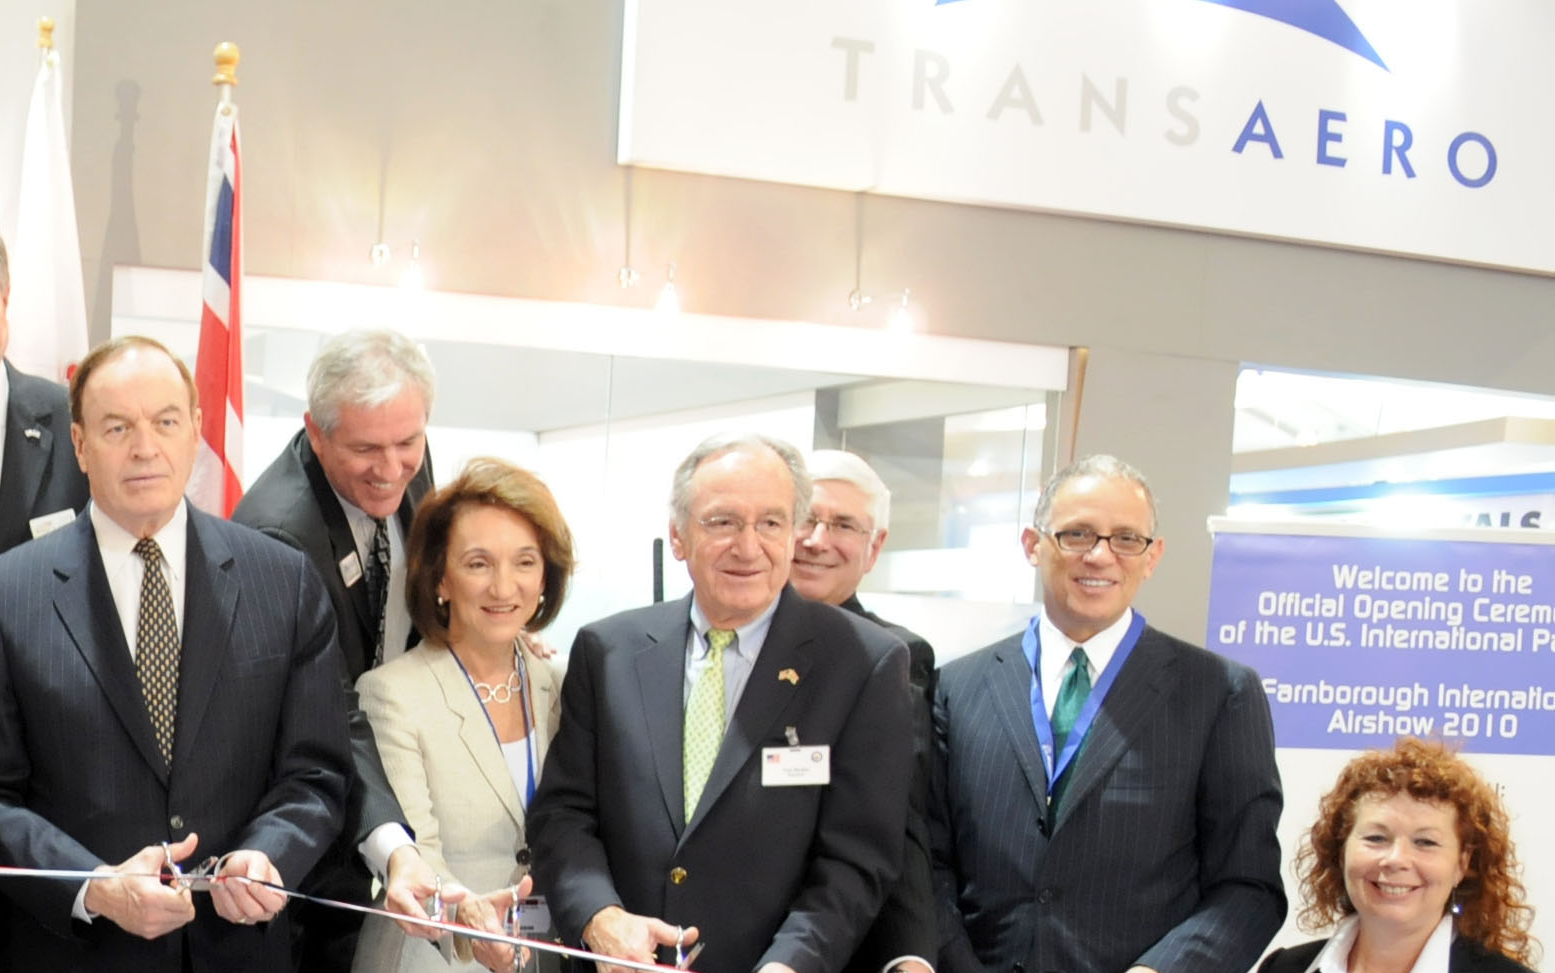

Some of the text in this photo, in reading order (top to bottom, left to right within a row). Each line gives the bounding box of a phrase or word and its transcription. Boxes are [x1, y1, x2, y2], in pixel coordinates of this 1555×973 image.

[832, 37, 1498, 189] TRANSAERO
[1332, 564, 1533, 594] Welcome to the
[1258, 591, 1555, 626] Official Opening Cerem
[1219, 620, 1246, 645] of
[1254, 621, 1295, 646] the
[1306, 622, 1351, 647] U.S.
[1361, 623, 1523, 652] International
[1261, 678, 1428, 711] Farnborough
[1327, 709, 1518, 738] Airshow 2010
